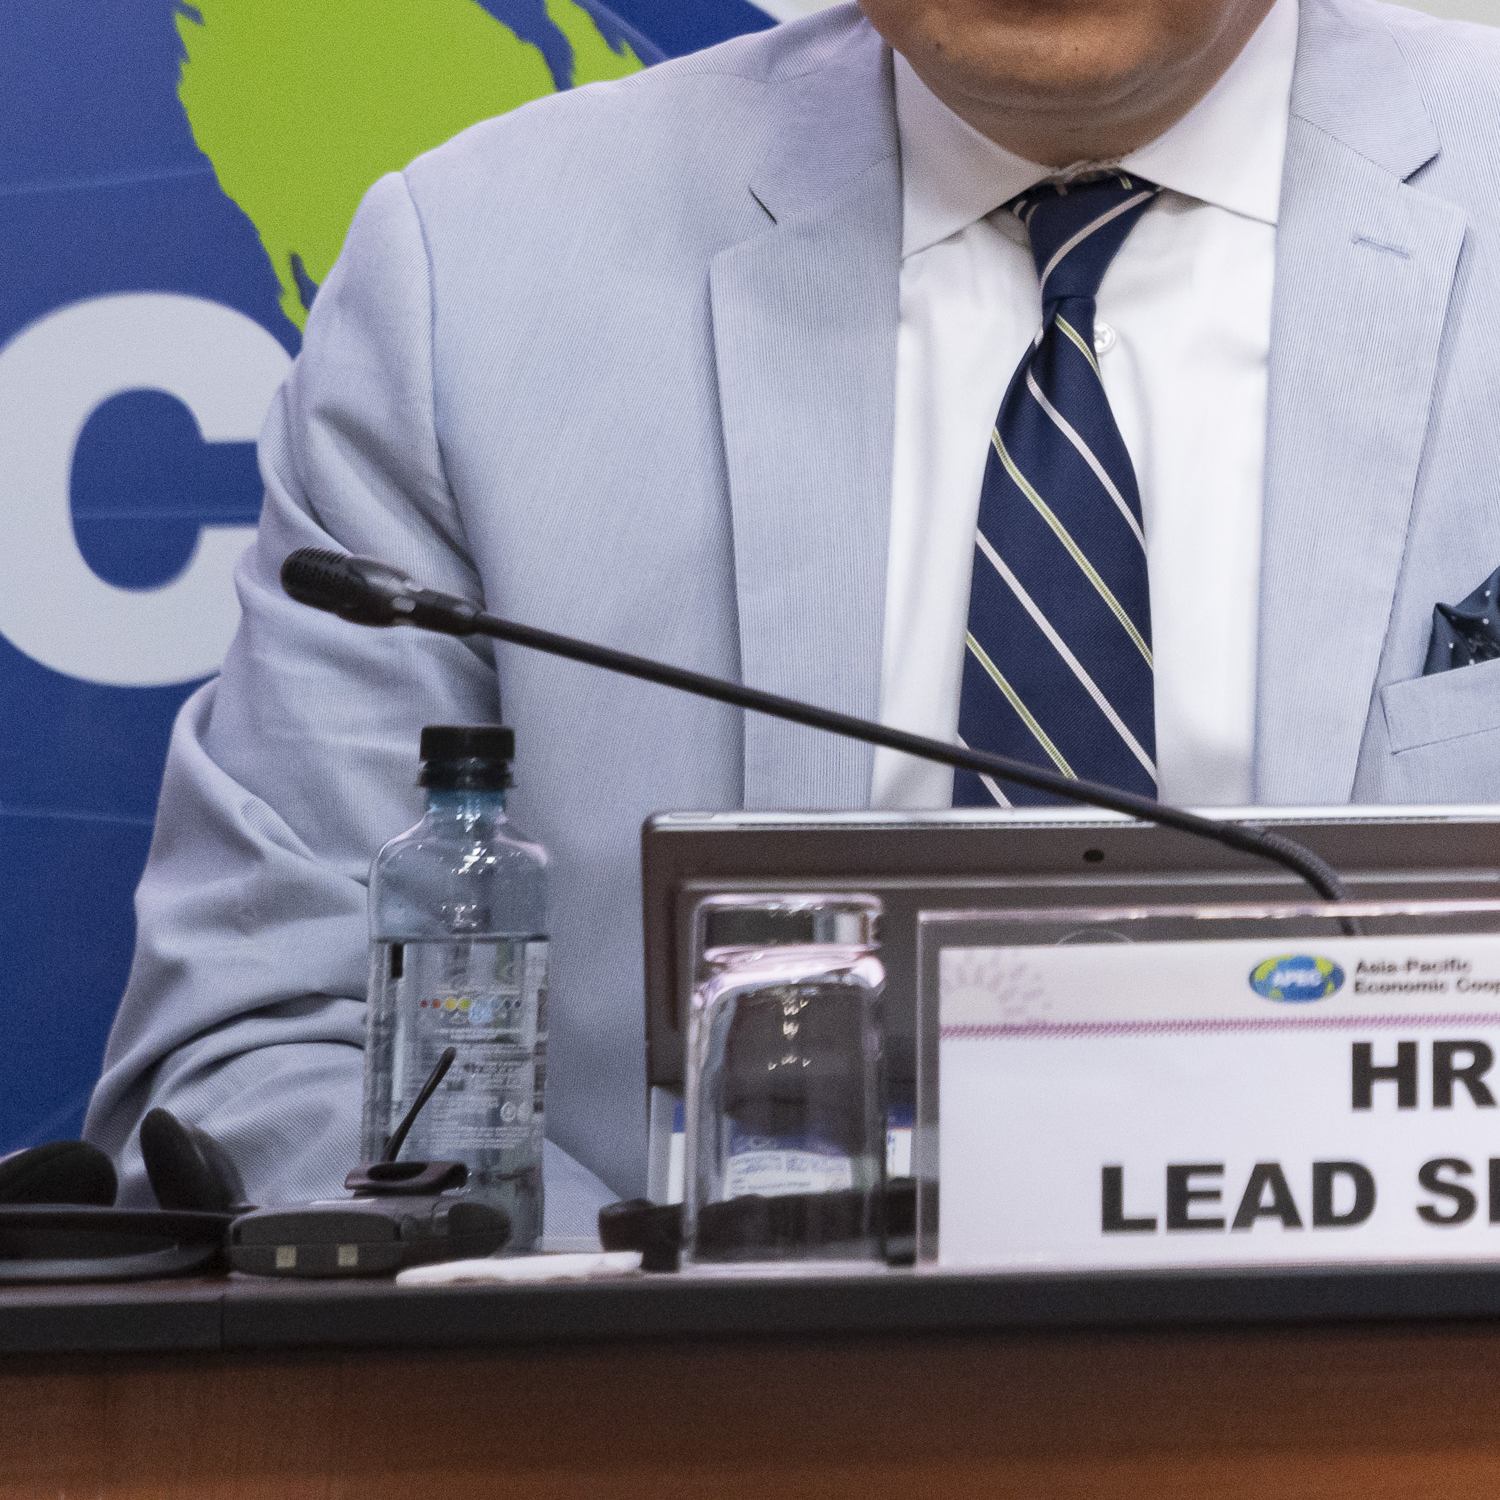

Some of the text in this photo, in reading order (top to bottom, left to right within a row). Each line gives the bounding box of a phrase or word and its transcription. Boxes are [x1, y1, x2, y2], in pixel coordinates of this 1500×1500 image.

[1356, 958, 1472, 975] Asia-Pacific
[1273, 968, 1322, 988] APEC
[1354, 978, 1448, 996] Economic
[1102, 1162, 1378, 1235] LEAD
